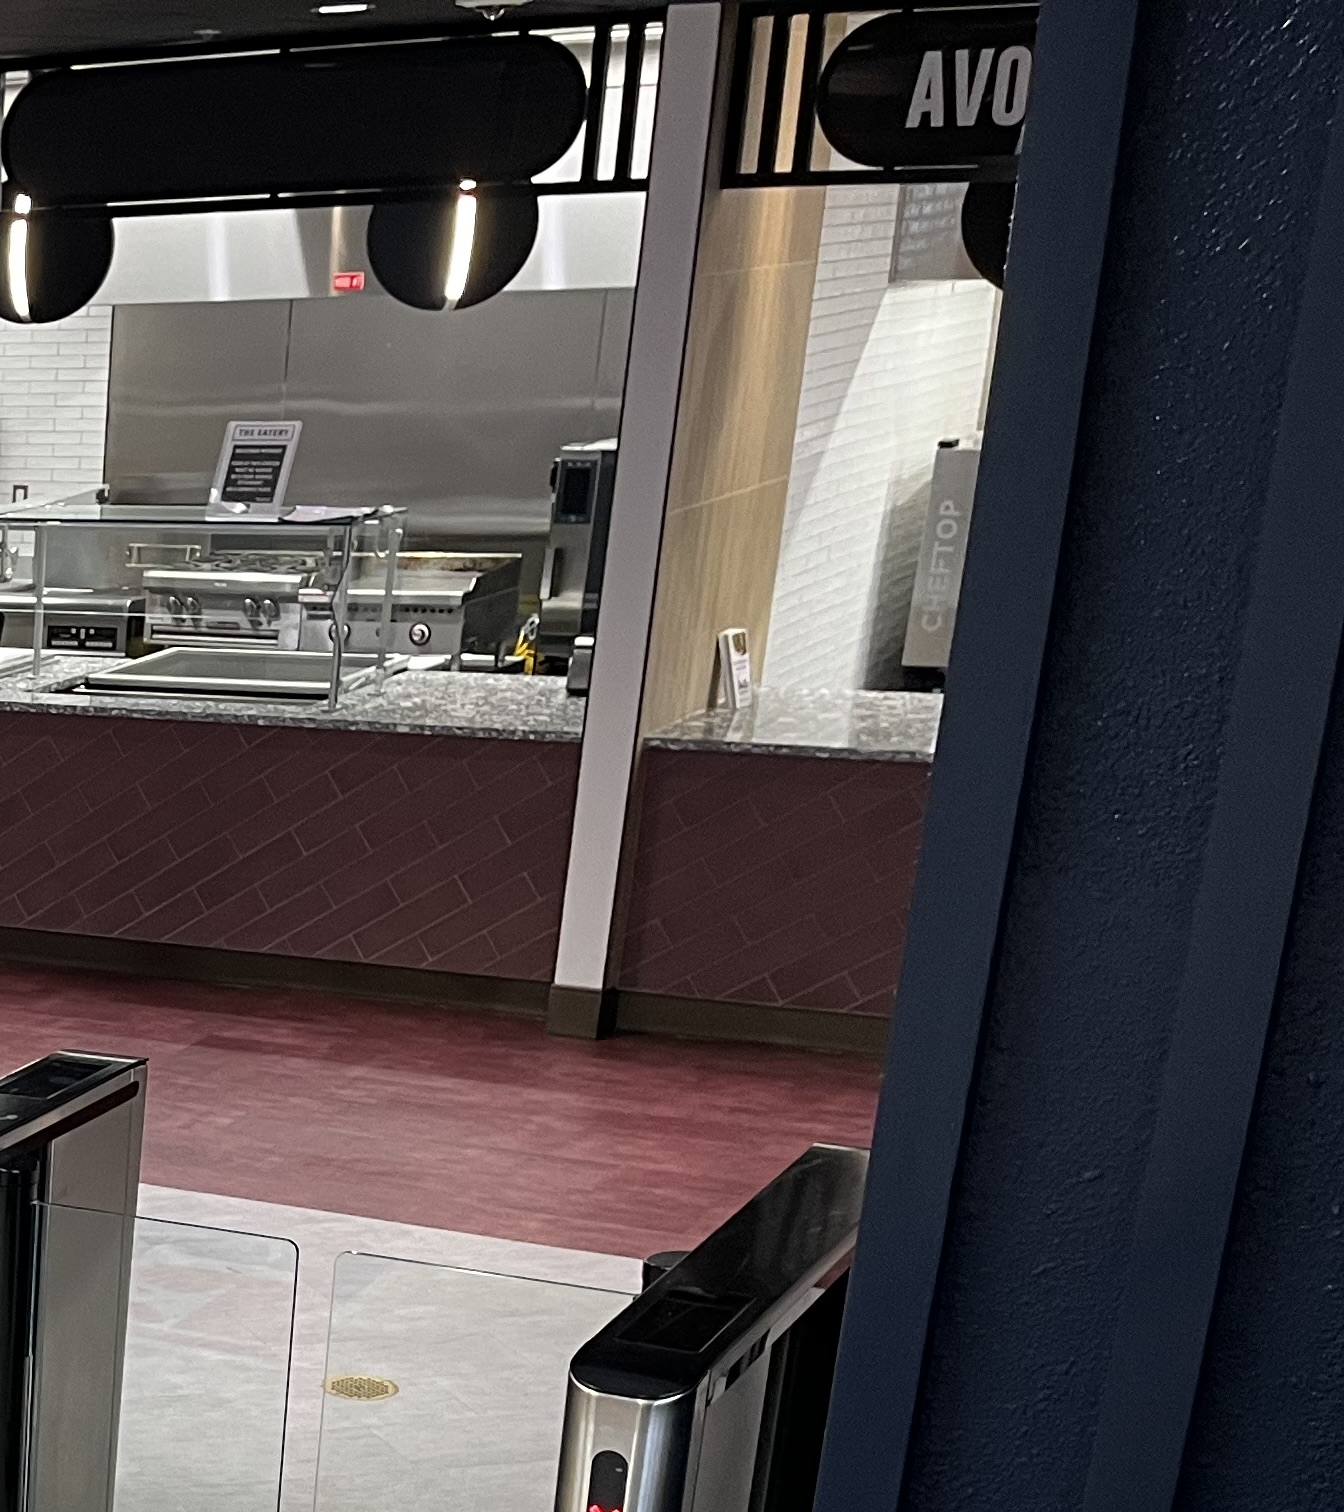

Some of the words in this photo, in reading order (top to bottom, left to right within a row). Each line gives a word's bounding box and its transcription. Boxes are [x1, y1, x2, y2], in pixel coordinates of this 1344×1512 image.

[238, 429, 255, 437] THE
[257, 429, 289, 437] EATERY
[920, 499, 961, 632] CHEFTOP
